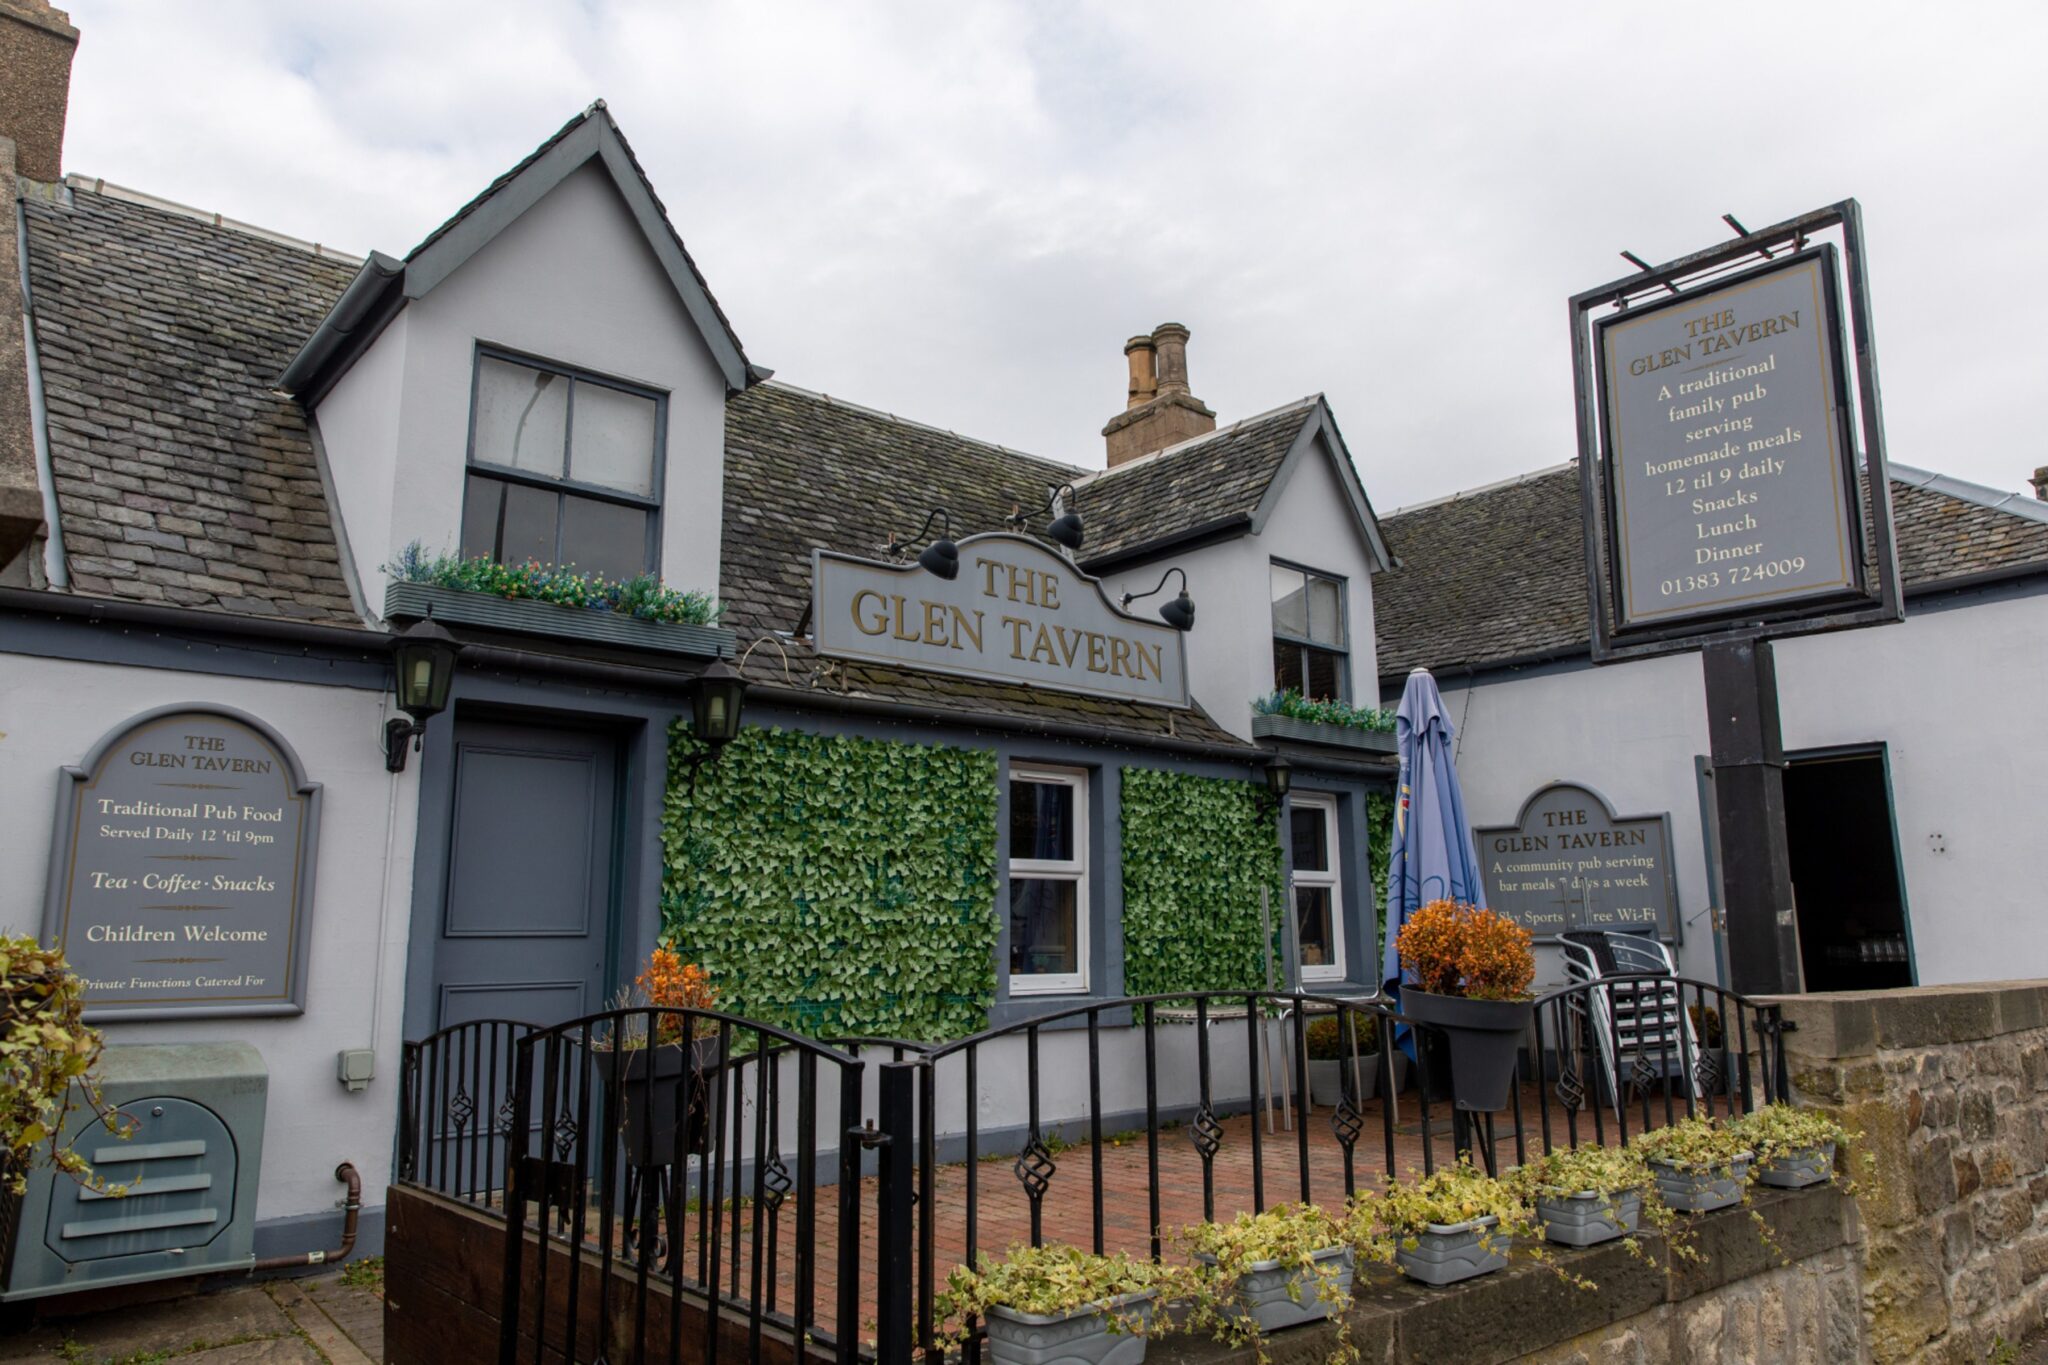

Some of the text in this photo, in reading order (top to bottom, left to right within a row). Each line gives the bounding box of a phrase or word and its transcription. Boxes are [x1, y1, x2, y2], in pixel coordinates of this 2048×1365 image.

[1684, 308, 1735, 339] THE
[1628, 310, 1800, 377] GLEN TAVERN
[1657, 354, 1776, 402] A traditional
[1668, 384, 1767, 423] family pub
[1685, 414, 1754, 443] serving
[1645, 427, 1802, 478] homemade meals
[1665, 457, 1786, 497] 12 til 9 daily
[1692, 489, 1758, 516] Snacks
[1696, 515, 1757, 540] Lunch
[1695, 541, 1763, 565] Dinner
[976, 557, 1061, 610] THE
[1661, 556, 1806, 596] 01383 724009
[850, 588, 1162, 684] GLEN TAVERN
[184, 735, 225, 752] THE
[129, 752, 272, 775] GLEN TAVERN
[98, 799, 283, 823] Traditional Pub Food
[1543, 810, 1588, 828] THE
[100, 825, 150, 840] Served
[155, 826, 194, 843] Daily
[200, 828, 216, 842] 12
[245, 831, 274, 846] 9pm
[1495, 829, 1646, 853] GLEN TAVERN
[1493, 854, 1654, 874] A community pub serving
[90, 872, 276, 895] Tea Coffee Snacks
[1499, 879, 1517, 892] bar
[1522, 878, 1555, 891] meals
[1571, 876, 1600, 892] dys
[1603, 879, 1611, 888] a
[1615, 873, 1649, 887] week
[1524, 910, 1564, 926] Sports
[1589, 912, 1613, 922] ree
[1617, 906, 1656, 922] Wi-Fi
[86, 924, 268, 943] Children Welcome
[130, 976, 191, 989] Functions
[195, 975, 241, 988] Catered
[244, 975, 265, 987] For
